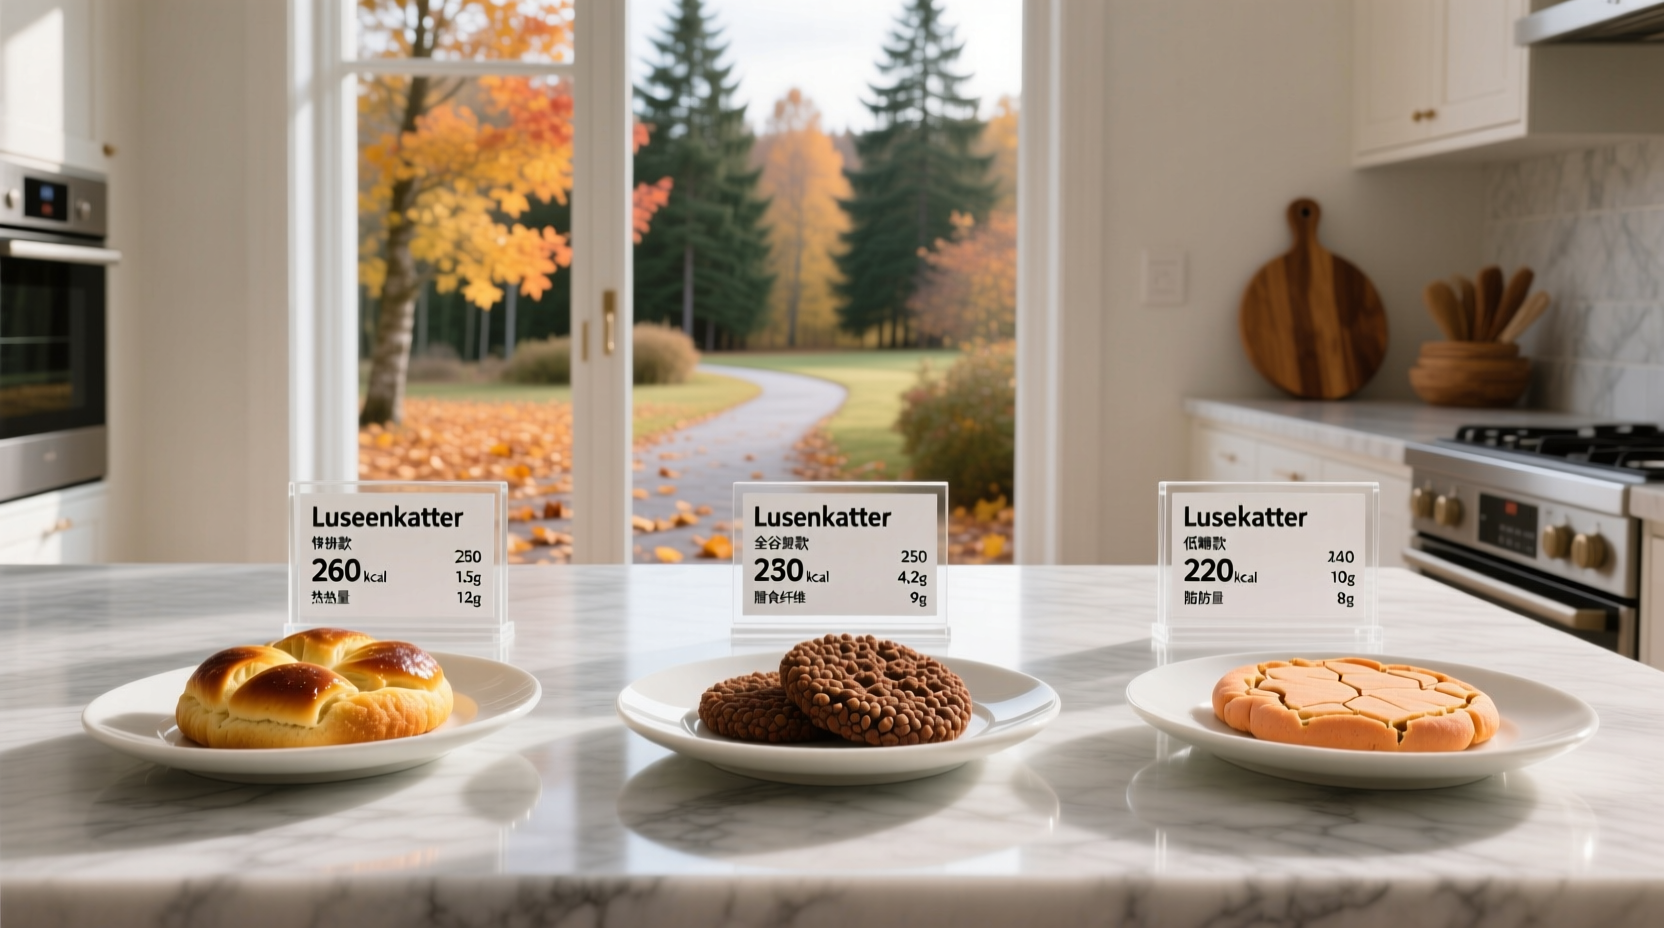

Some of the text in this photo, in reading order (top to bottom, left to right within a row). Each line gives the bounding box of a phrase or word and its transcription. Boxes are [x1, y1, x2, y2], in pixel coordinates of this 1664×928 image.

[312, 504, 464, 528] Luseenkatter
[754, 504, 892, 528] Lusenkatter
[1184, 504, 1308, 528] Lusekatter
[900, 549, 928, 564] 250
[311, 557, 387, 583] 260 kcal
[455, 570, 482, 587] 1.5g
[753, 557, 830, 583] 230 kcal
[1183, 557, 1258, 584] 220 kcal
[1330, 570, 1356, 587] 10g
[457, 590, 482, 608] 12g
[909, 591, 927, 608] 9g
[1337, 591, 1355, 608] 8g
